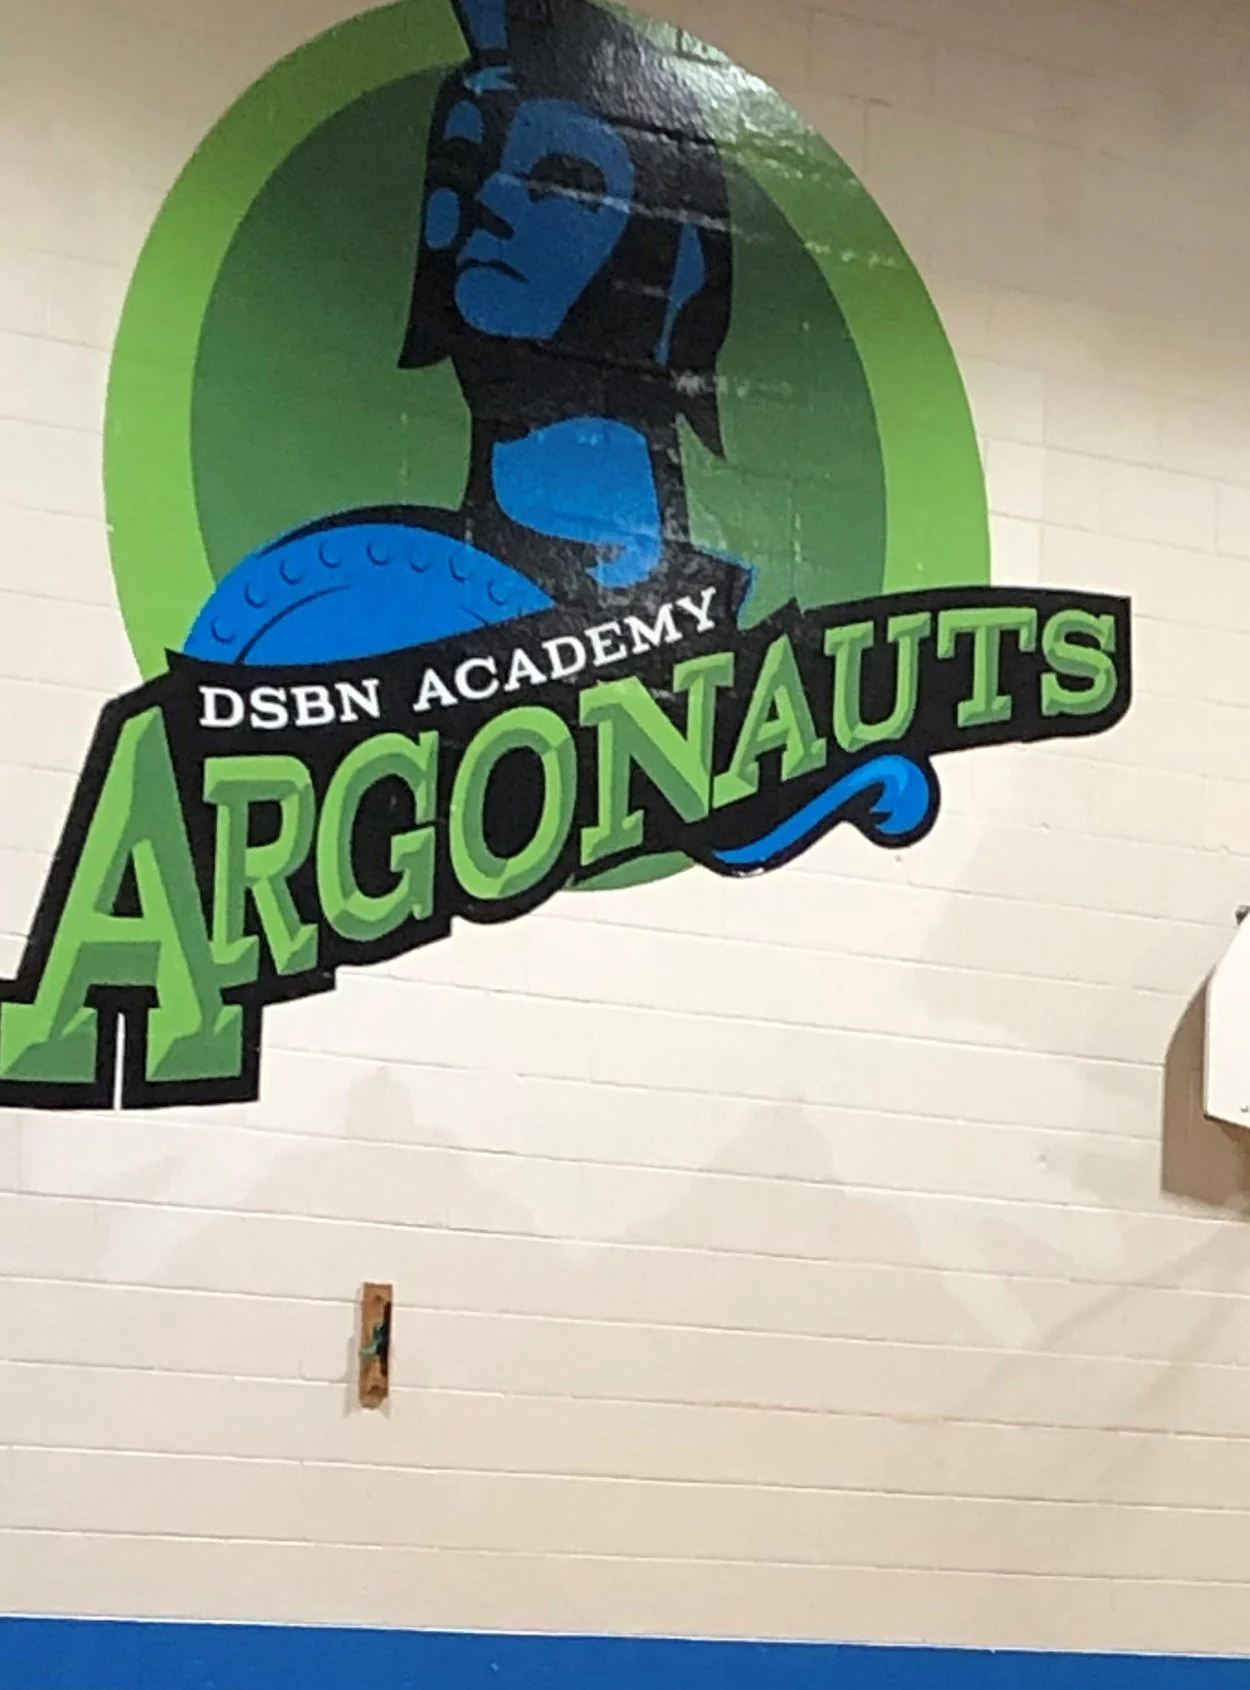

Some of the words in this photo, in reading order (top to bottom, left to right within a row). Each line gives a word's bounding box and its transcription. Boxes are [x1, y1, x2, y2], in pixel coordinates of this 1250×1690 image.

[199, 679, 381, 729] DSBN
[412, 586, 717, 711] ACADEMY
[0, 608, 1119, 1083] ARGONAUTS
